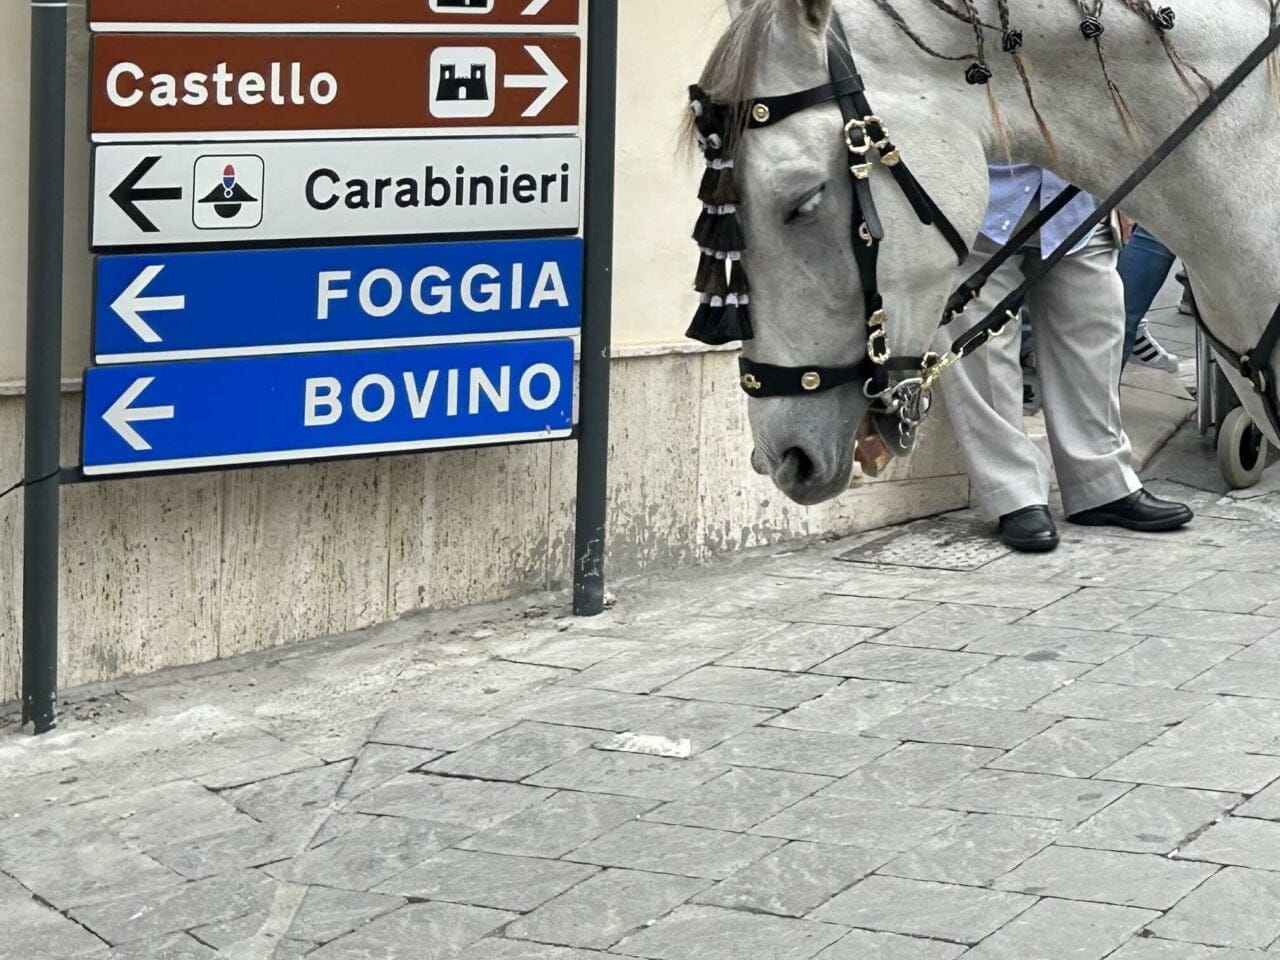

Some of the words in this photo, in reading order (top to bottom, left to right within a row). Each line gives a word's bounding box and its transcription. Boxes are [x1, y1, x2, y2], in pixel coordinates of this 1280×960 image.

[106, 61, 338, 107] Castello
[305, 162, 569, 211] Carabinieri
[317, 261, 569, 320] FOGGIA
[303, 362, 561, 427] BOVINO
